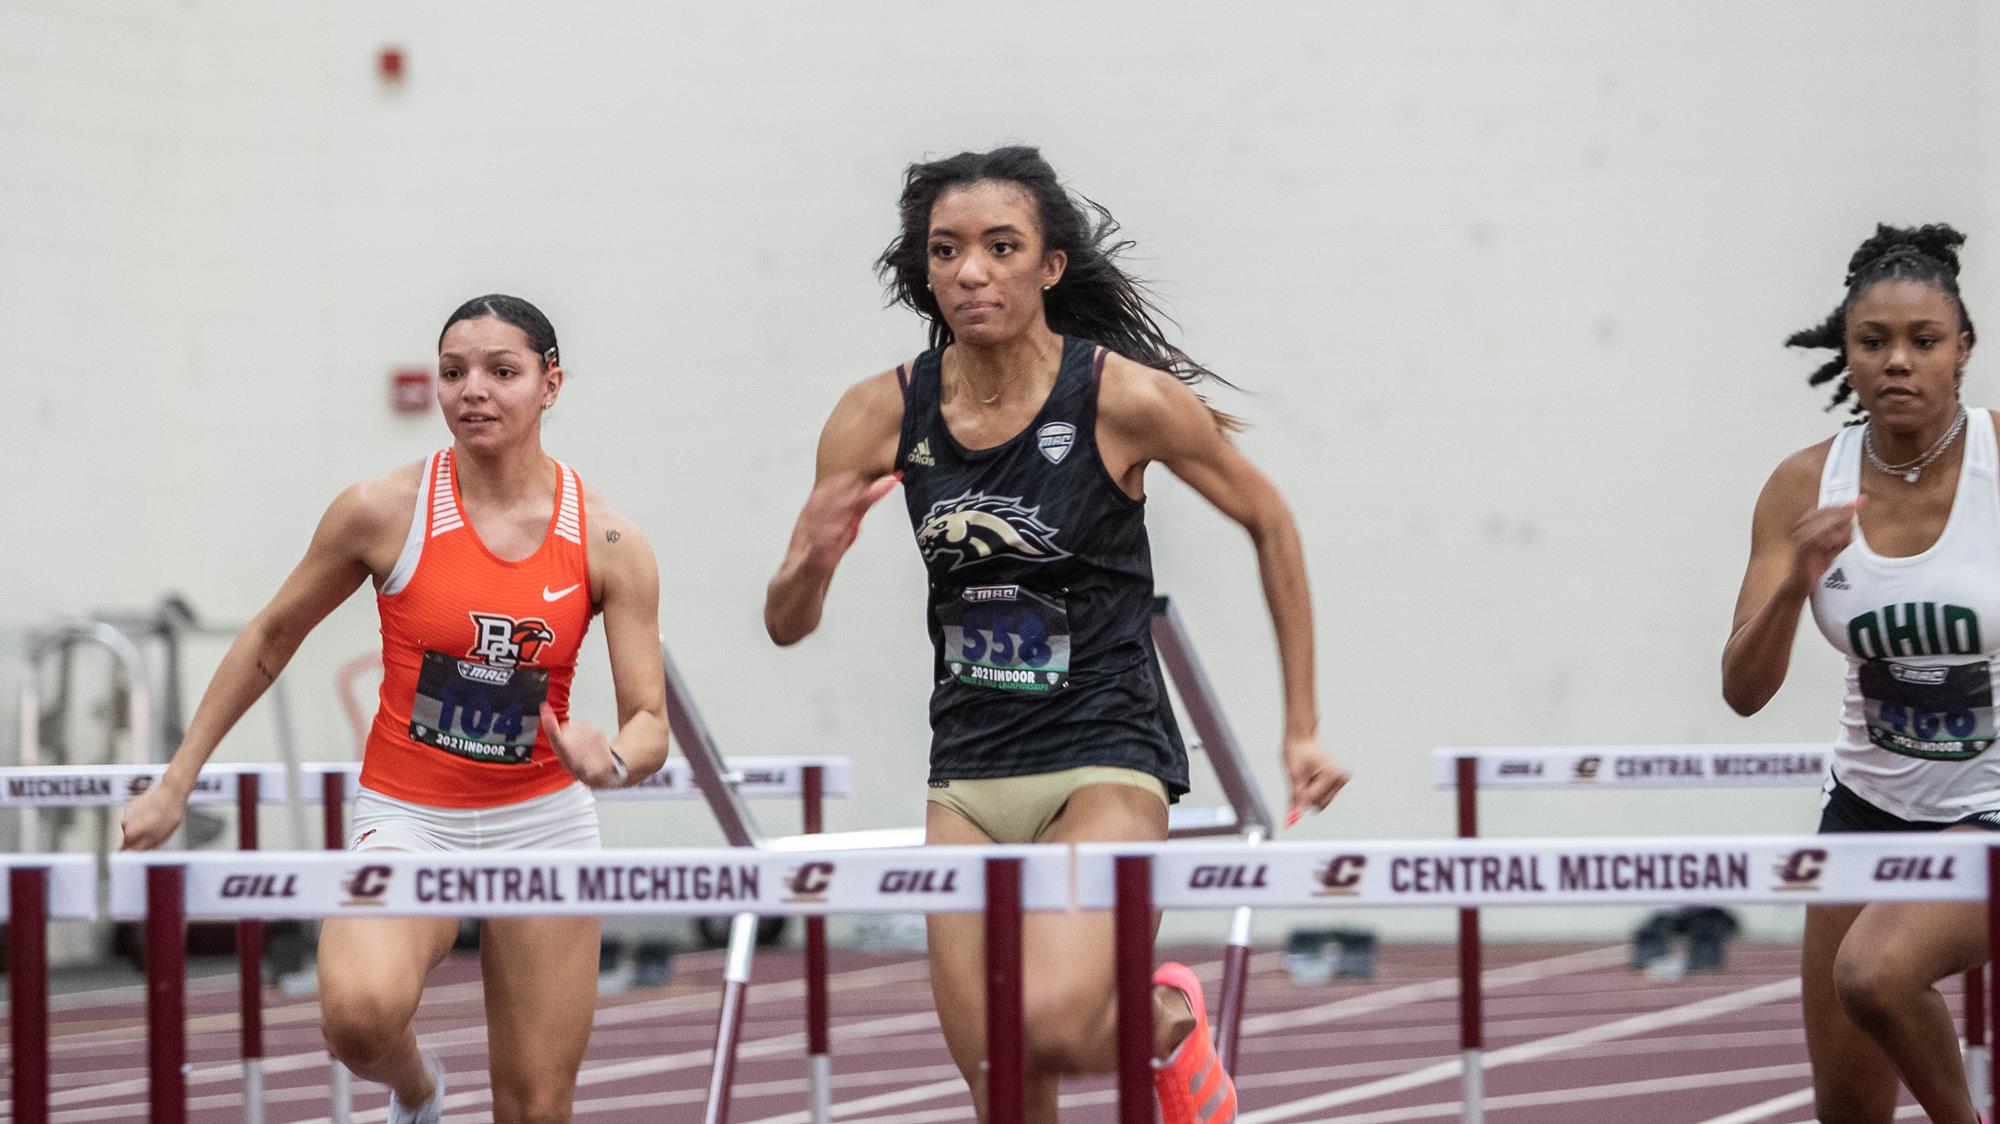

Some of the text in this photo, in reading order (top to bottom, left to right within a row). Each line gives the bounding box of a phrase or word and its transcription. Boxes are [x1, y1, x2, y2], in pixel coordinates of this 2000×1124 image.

[1039, 434, 1073, 447] MAC
[907, 452, 935, 466] adias
[976, 588, 1014, 600] MAC
[962, 608, 1052, 667] 558
[1848, 602, 1980, 659] OHIO
[469, 666, 509, 682] MAC
[438, 687, 524, 742] 104
[1614, 757, 1705, 777] CENTRAL
[1712, 754, 1823, 776] MICHIGAN
[8, 775, 113, 797] MICHIGAN
[220, 873, 299, 899] GILL
[415, 866, 564, 902] CENTRAL
[577, 863, 760, 900] MICHIGAN
[878, 868, 959, 894] GILL
[1188, 864, 1269, 889] GILL
[1390, 856, 1544, 893] CENTRAL
[1558, 852, 1749, 891] MICHIGAN
[1873, 855, 1957, 881] GILL
